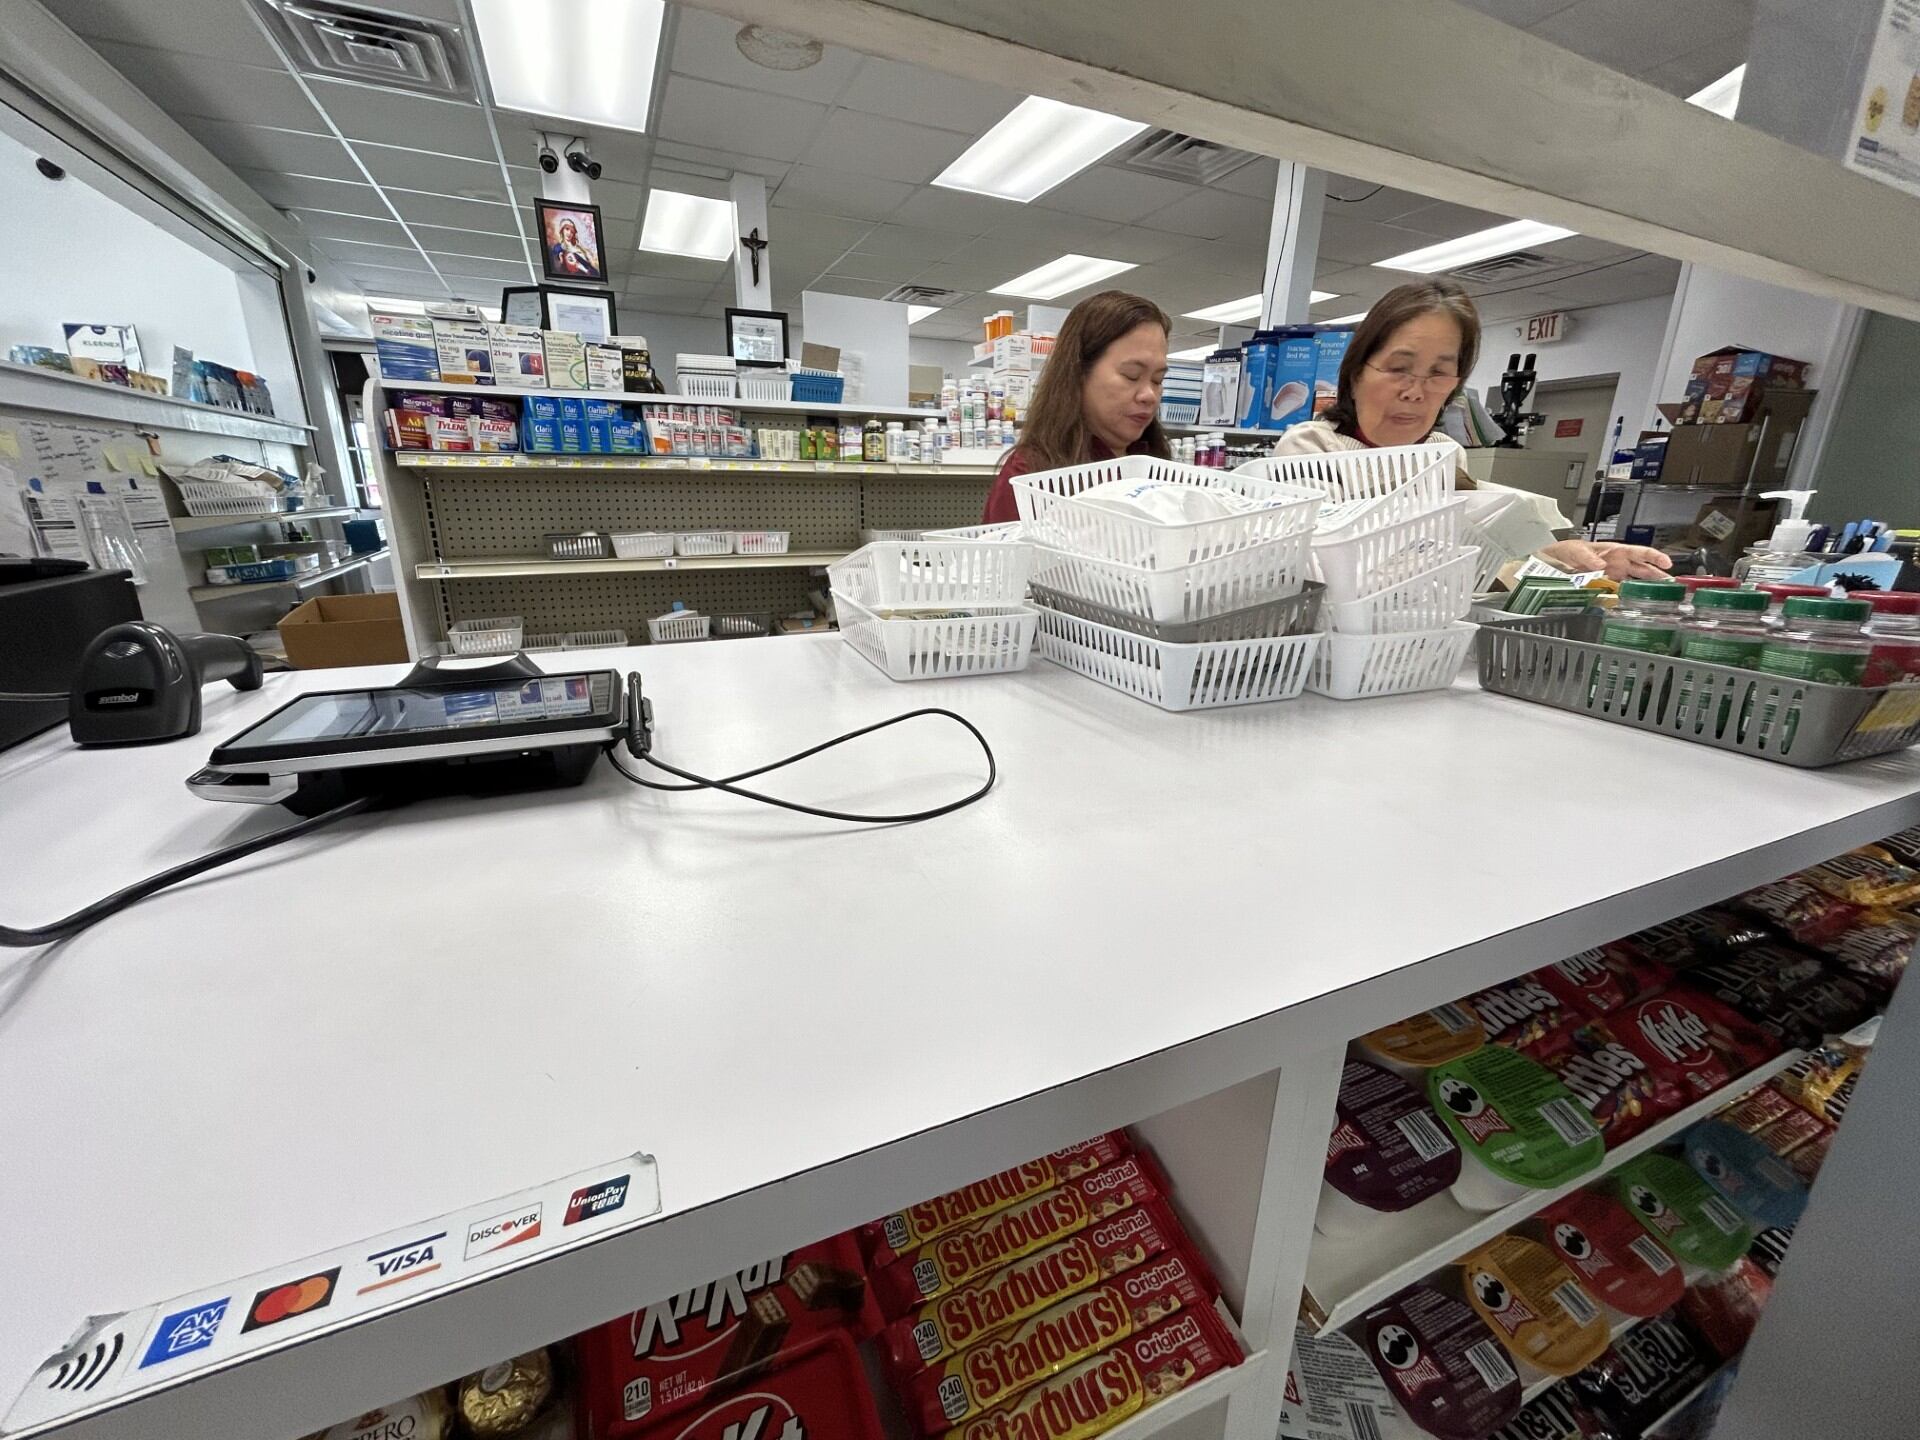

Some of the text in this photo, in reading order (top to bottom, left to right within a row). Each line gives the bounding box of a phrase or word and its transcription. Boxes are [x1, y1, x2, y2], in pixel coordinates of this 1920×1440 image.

[382, 328, 413, 338] nicotine
[1527, 315, 1559, 341] EXIT
[82, 340, 121, 348] KLEENEX
[480, 422, 511, 433] TYLENOL
[98, 692, 140, 705] symbol
[1637, 1003, 1709, 1064] KitKat
[1084, 1162, 1137, 1194] Original
[570, 1183, 627, 1209] UnionPay
[469, 1212, 539, 1244] DISCOVER
[885, 1217, 904, 1235] 240
[940, 1186, 1085, 1279] Starburst
[1094, 1210, 1150, 1246] Original
[375, 1246, 434, 1277] VISA
[913, 1262, 934, 1281] 240
[941, 1238, 1094, 1342] Starburst
[1126, 1260, 1184, 1297] Original
[168, 1304, 230, 1338] AM
[914, 1323, 935, 1342] 240
[968, 1290, 1126, 1400] Starburst
[1137, 1317, 1198, 1361] Original
[659, 1370, 688, 1393] NET WT
[1395, 1355, 1442, 1396] PRINGLES
[625, 1380, 649, 1403] 210
[659, 1388, 673, 1405] 1.5
[940, 1379, 962, 1401] 240
